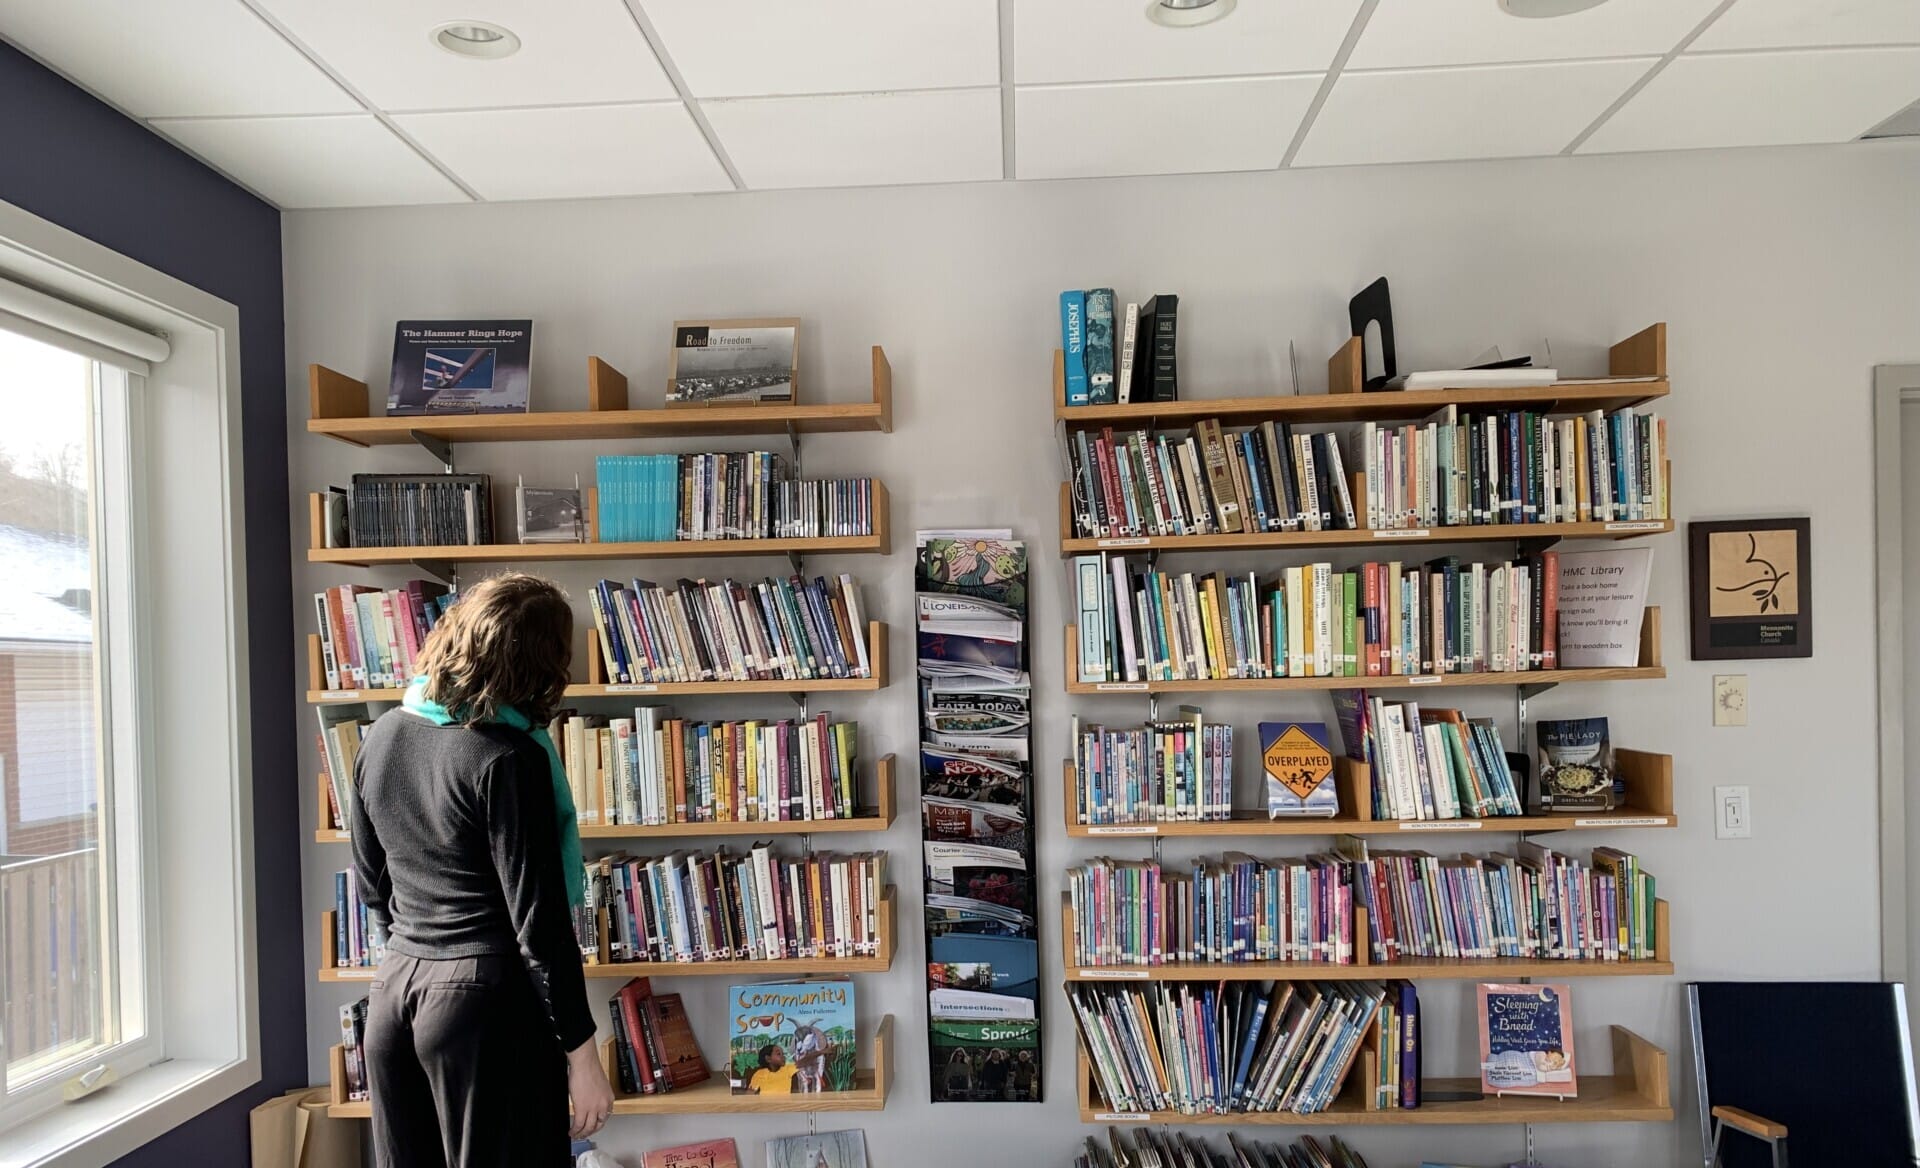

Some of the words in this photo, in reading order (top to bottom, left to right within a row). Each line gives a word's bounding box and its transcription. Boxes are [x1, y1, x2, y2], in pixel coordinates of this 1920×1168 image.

[402, 329, 421, 338] The
[424, 329, 465, 338] Hammer
[468, 329, 495, 338] Rings
[497, 329, 523, 338] Hope
[1068, 302, 1080, 354] JOSEPHUS
[686, 334, 707, 346] Road
[709, 337, 717, 346] to
[720, 335, 752, 346] Freedom
[1139, 430, 1149, 459] READING
[1145, 461, 1153, 480] WHILE
[1150, 483, 1159, 505] BLACK
[1642, 469, 1651, 495] Worship
[1563, 566, 1586, 577] HMC
[1590, 565, 1625, 576] Library
[1463, 591, 1470, 600] UP
[1346, 603, 1354, 617] fully
[1222, 616, 1230, 638] Amish
[1604, 619, 1621, 627] bring
[1345, 617, 1353, 644] engaged
[937, 702, 974, 711] FAITH
[978, 702, 1021, 712] TODAY
[1577, 731, 1601, 739] LADY
[1268, 756, 1329, 767] OVERPLAYED
[738, 986, 846, 1009] Community
[940, 1003, 1004, 1012] Intersections
[1494, 996, 1540, 1015] Sleeping
[1508, 1011, 1529, 1020] with
[1406, 1014, 1414, 1037] Shine
[1499, 1018, 1534, 1031] Bread
[981, 1027, 1031, 1041] Sprout
[1406, 1040, 1414, 1052] On
[664, 1153, 683, 1163] Time
[687, 1151, 697, 1159] to
